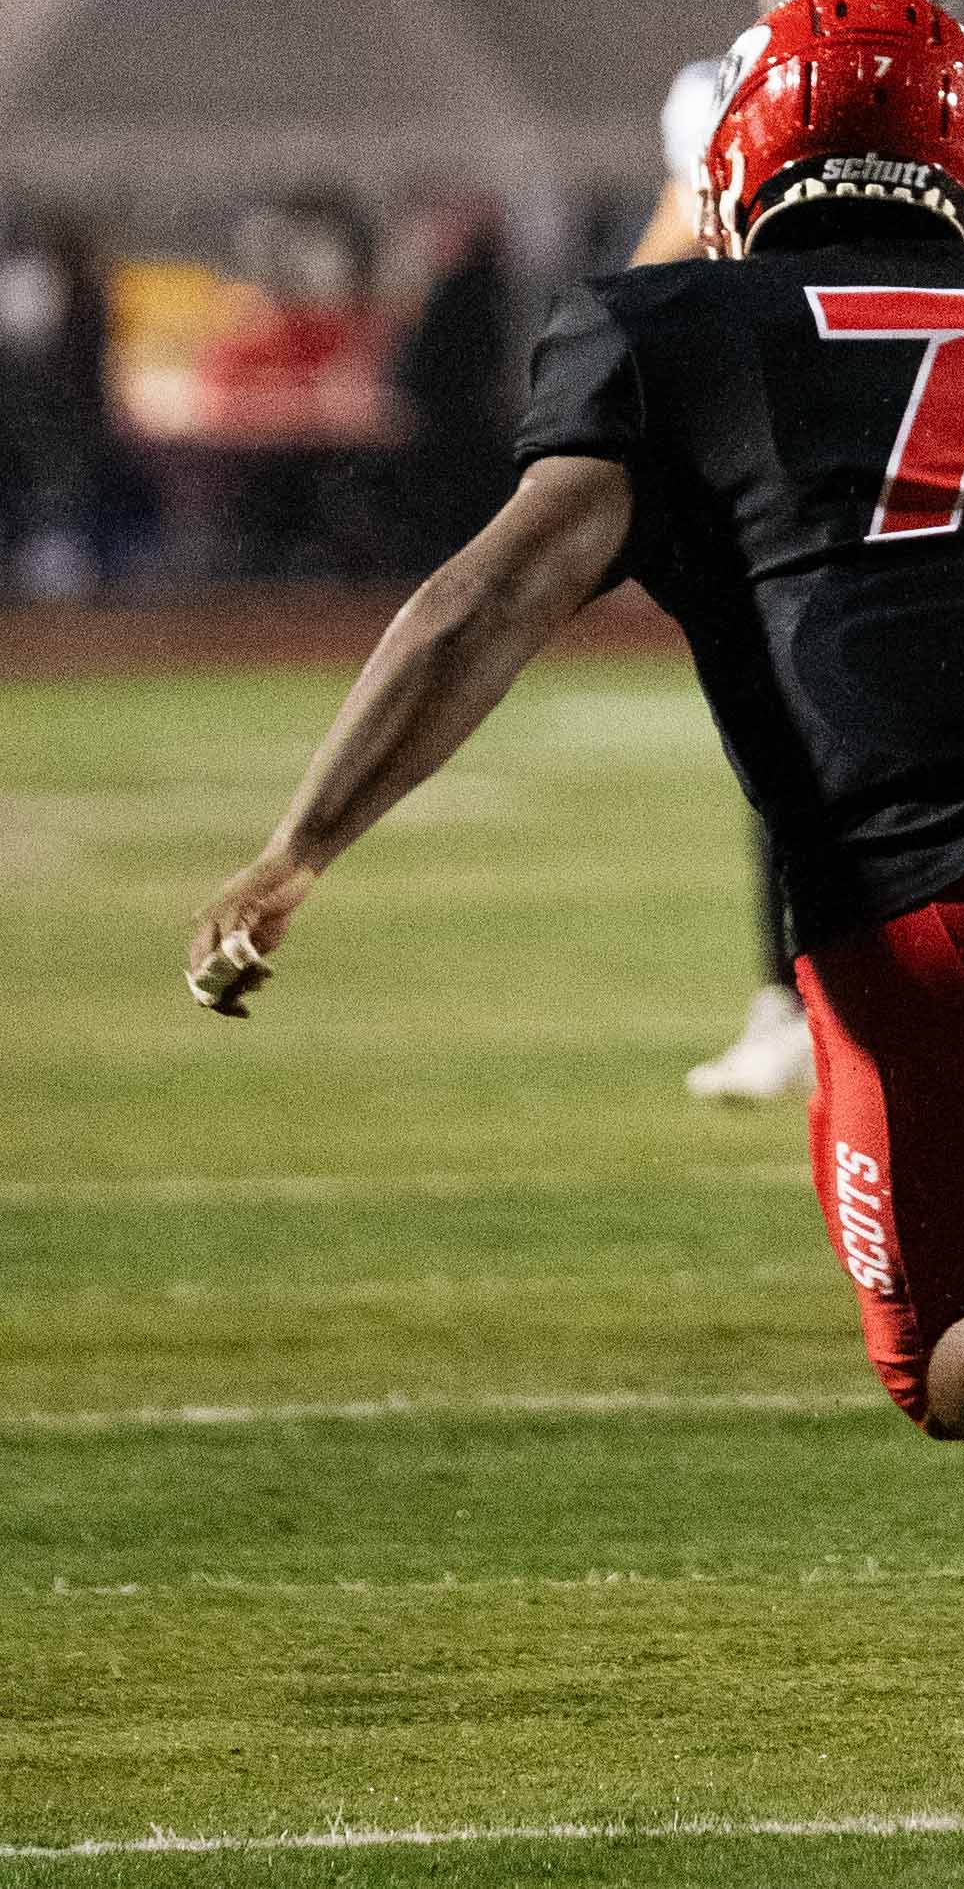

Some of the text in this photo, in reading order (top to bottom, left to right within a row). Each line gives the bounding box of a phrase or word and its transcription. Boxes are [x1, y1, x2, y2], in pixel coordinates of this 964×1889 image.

[874, 55, 893, 78] 7
[822, 152, 930, 188] schutt
[836, 1141, 894, 1295] SCOTS
